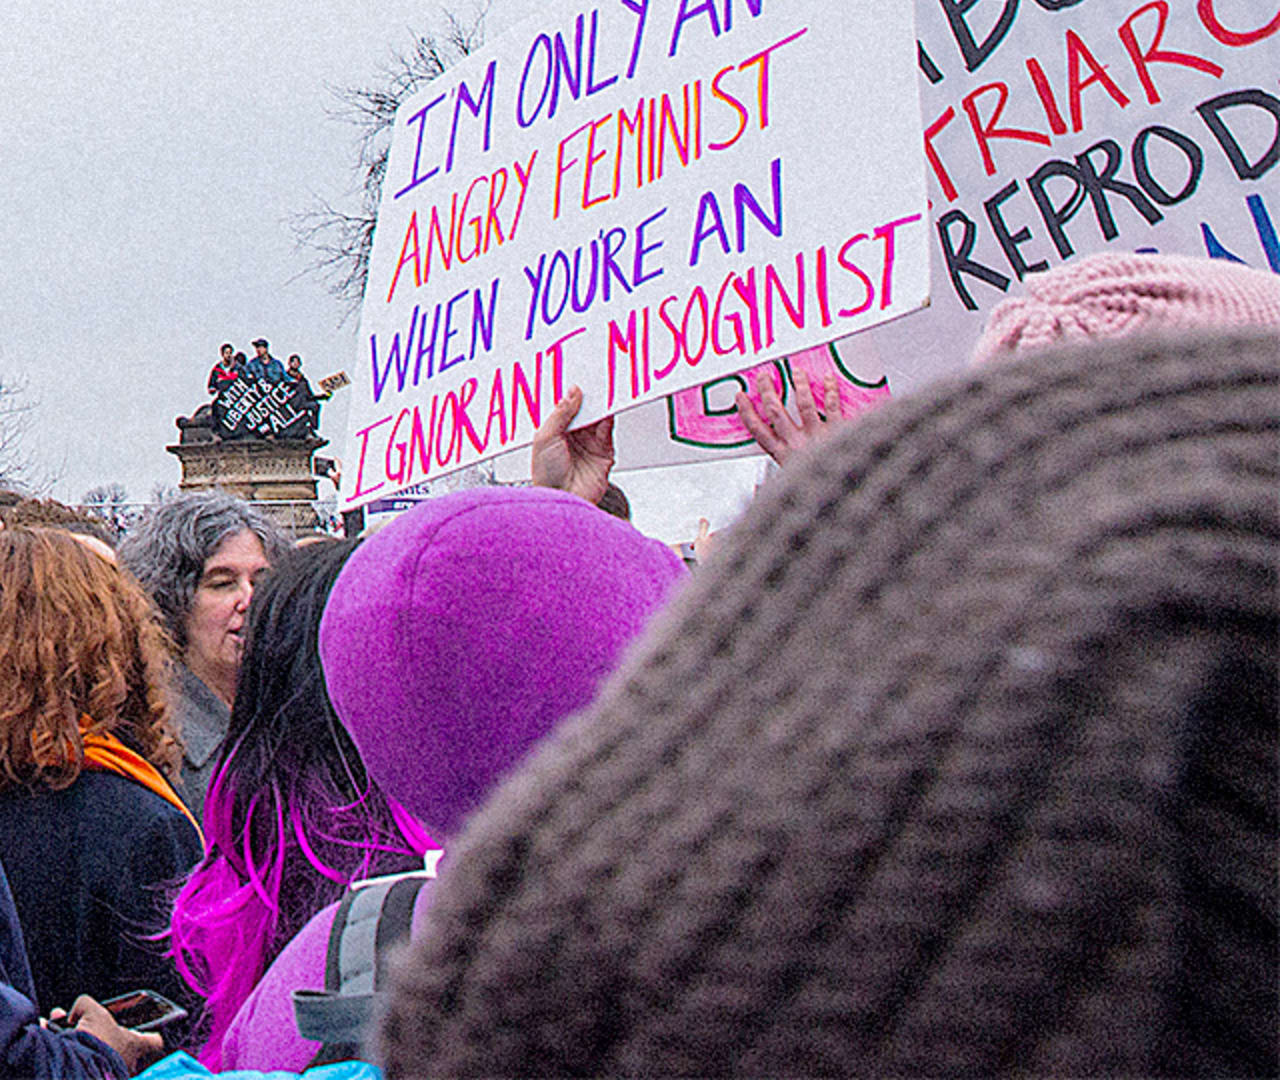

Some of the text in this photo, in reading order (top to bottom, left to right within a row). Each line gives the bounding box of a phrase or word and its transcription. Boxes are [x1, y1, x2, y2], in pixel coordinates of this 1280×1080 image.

[386, 26, 808, 303] ANGRY FEMINIST
[369, 157, 784, 404] WHEN YOU'RE AN
[345, 327, 587, 504] IGNORANT
[607, 213, 922, 410] MISOGYNIST
[217, 378, 249, 408] WITH
[222, 383, 262, 431] LIBERTY
[245, 381, 297, 430] JUSTICE
[269, 403, 306, 433] ALL
